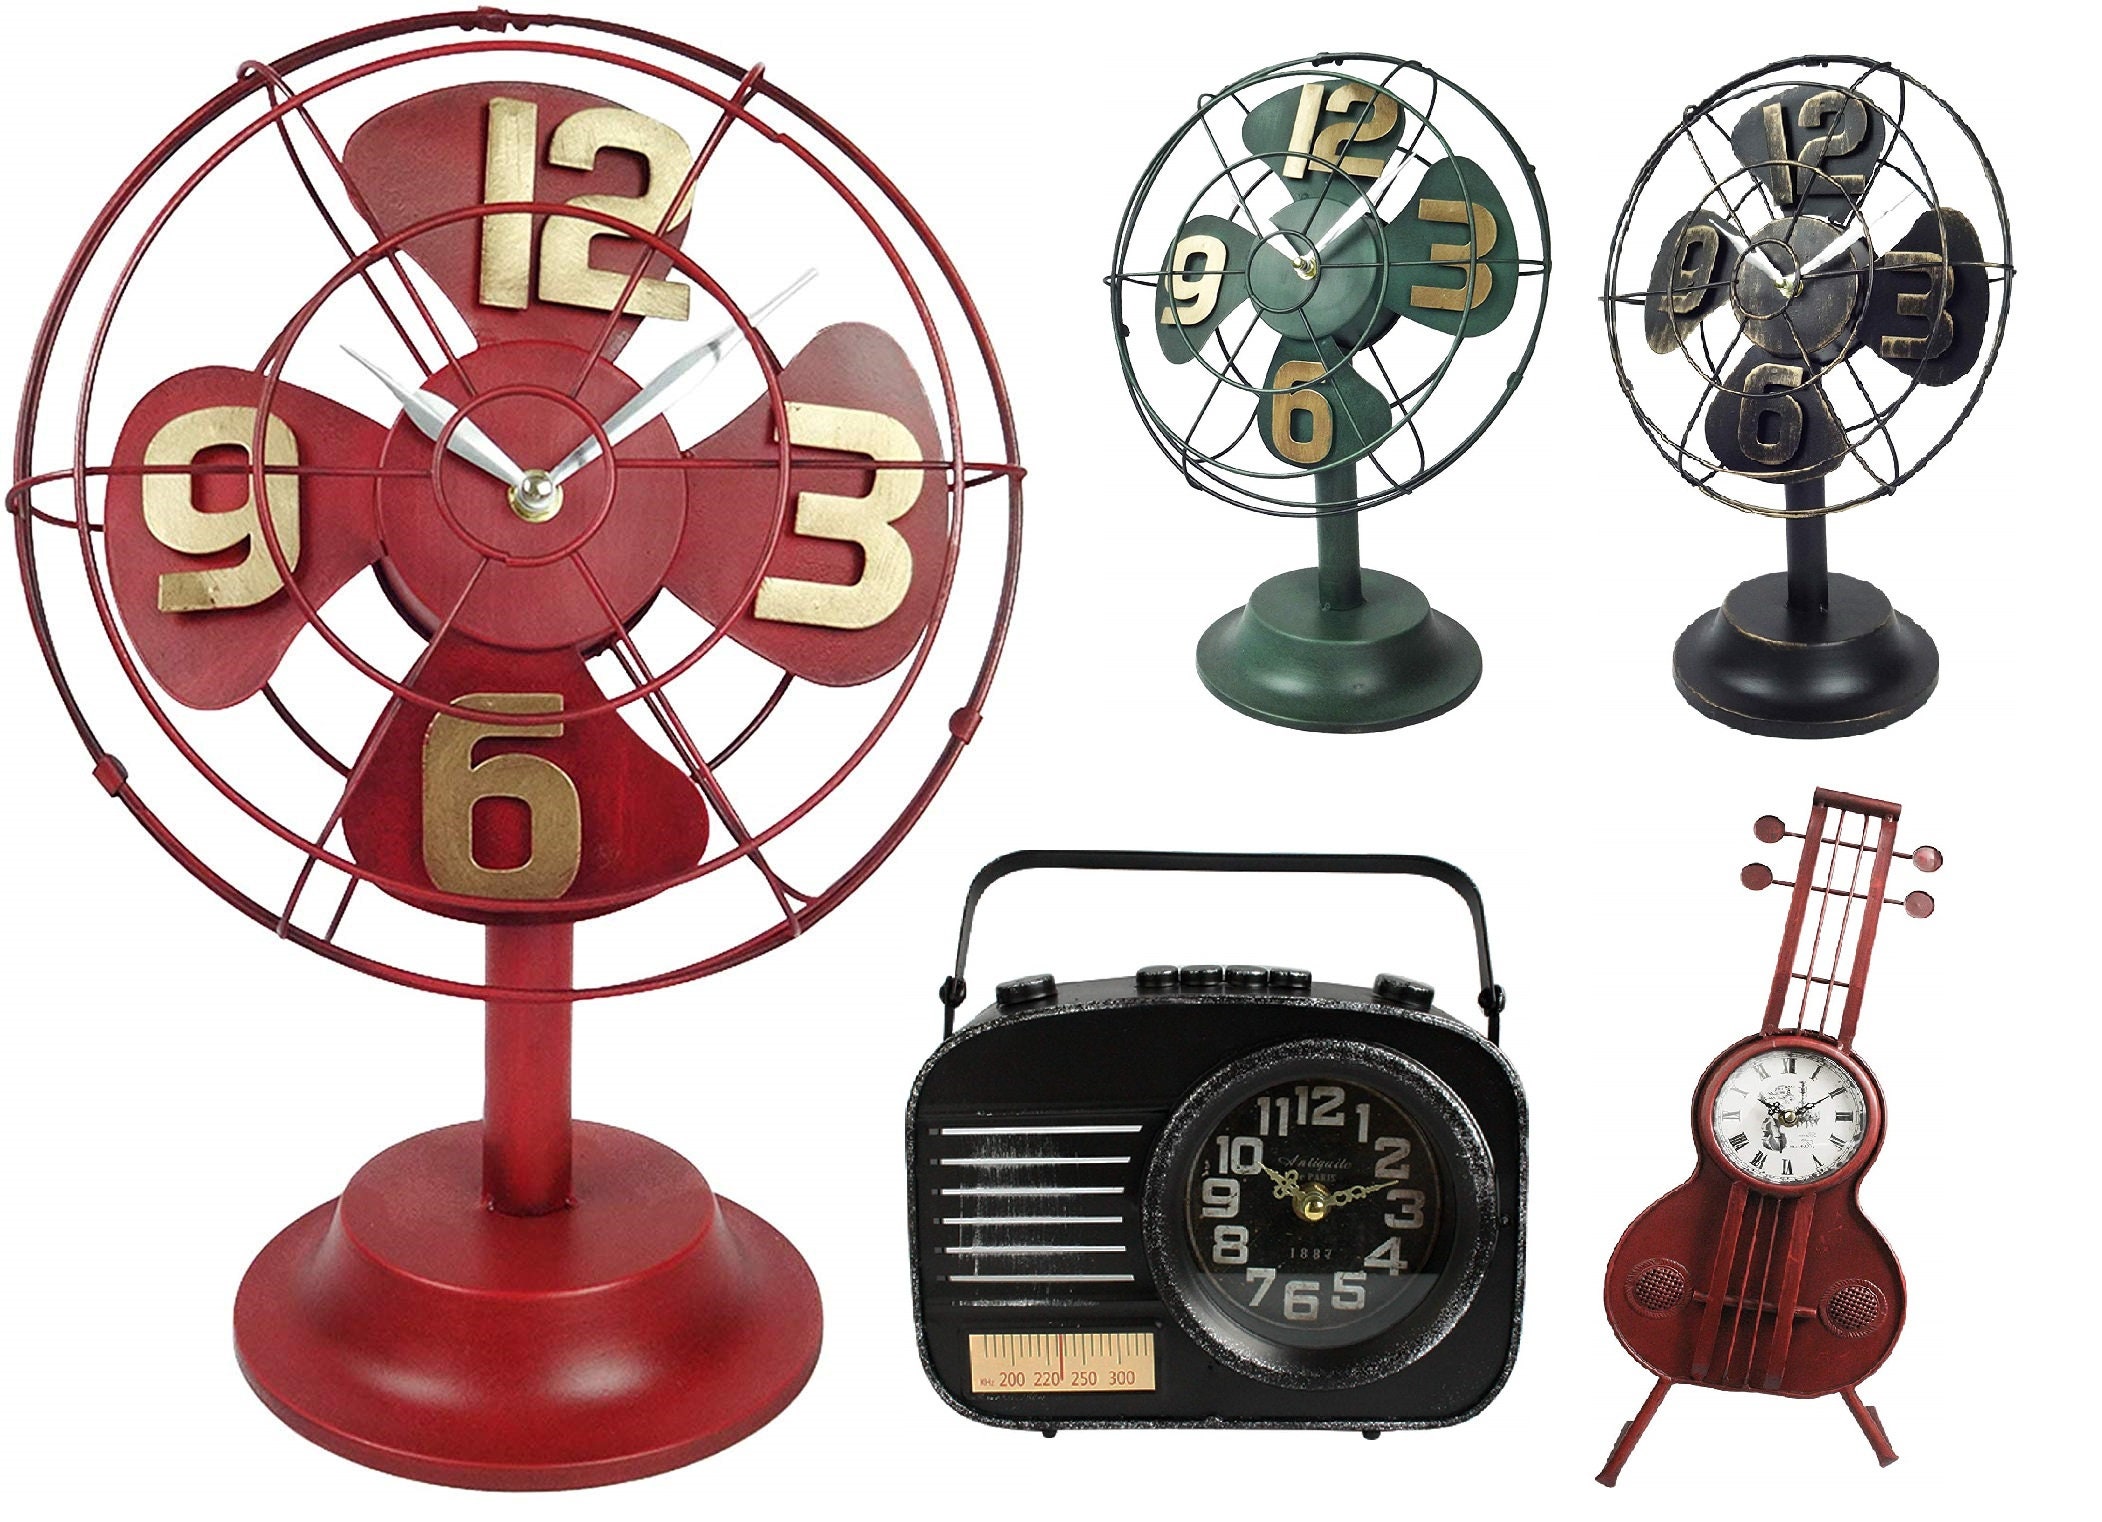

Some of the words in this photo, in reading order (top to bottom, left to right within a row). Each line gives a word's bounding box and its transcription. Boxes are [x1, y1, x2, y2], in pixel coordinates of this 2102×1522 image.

[1283, 83, 1399, 179] 12
[1762, 90, 1867, 206] 12
[478, 96, 696, 321] 12
[1411, 197, 1499, 312] 3
[1658, 224, 1721, 316] 9
[1160, 235, 1228, 326] 9
[1880, 251, 1956, 360] 3
[1271, 360, 1334, 464] 6
[1737, 363, 1805, 466] 6
[142, 404, 303, 614] 9
[752, 401, 926, 630] 3
[421, 692, 583, 900] 6
[1256, 1096, 1290, 1137] 11
[1294, 1085, 1346, 1127] 12
[1355, 1103, 1371, 1144] 1
[1215, 1135, 1264, 1176] 10
[1307, 1172, 1338, 1182] PARIS
[1374, 1136, 1412, 1180] 2
[1201, 1178, 1241, 1219] 9
[1384, 1189, 1426, 1230] 3
[1212, 1224, 1249, 1265] 8
[1363, 1236, 1409, 1277] 4
[1246, 1267, 1277, 1307] 7
[1283, 1280, 1321, 1321] 6
[1331, 1271, 1368, 1310] 5
[999, 1371, 1026, 1387] 200
[1033, 1371, 1060, 1387] 220
[1071, 1371, 1098, 1387] 250
[1108, 1371, 1136, 1387] 300
